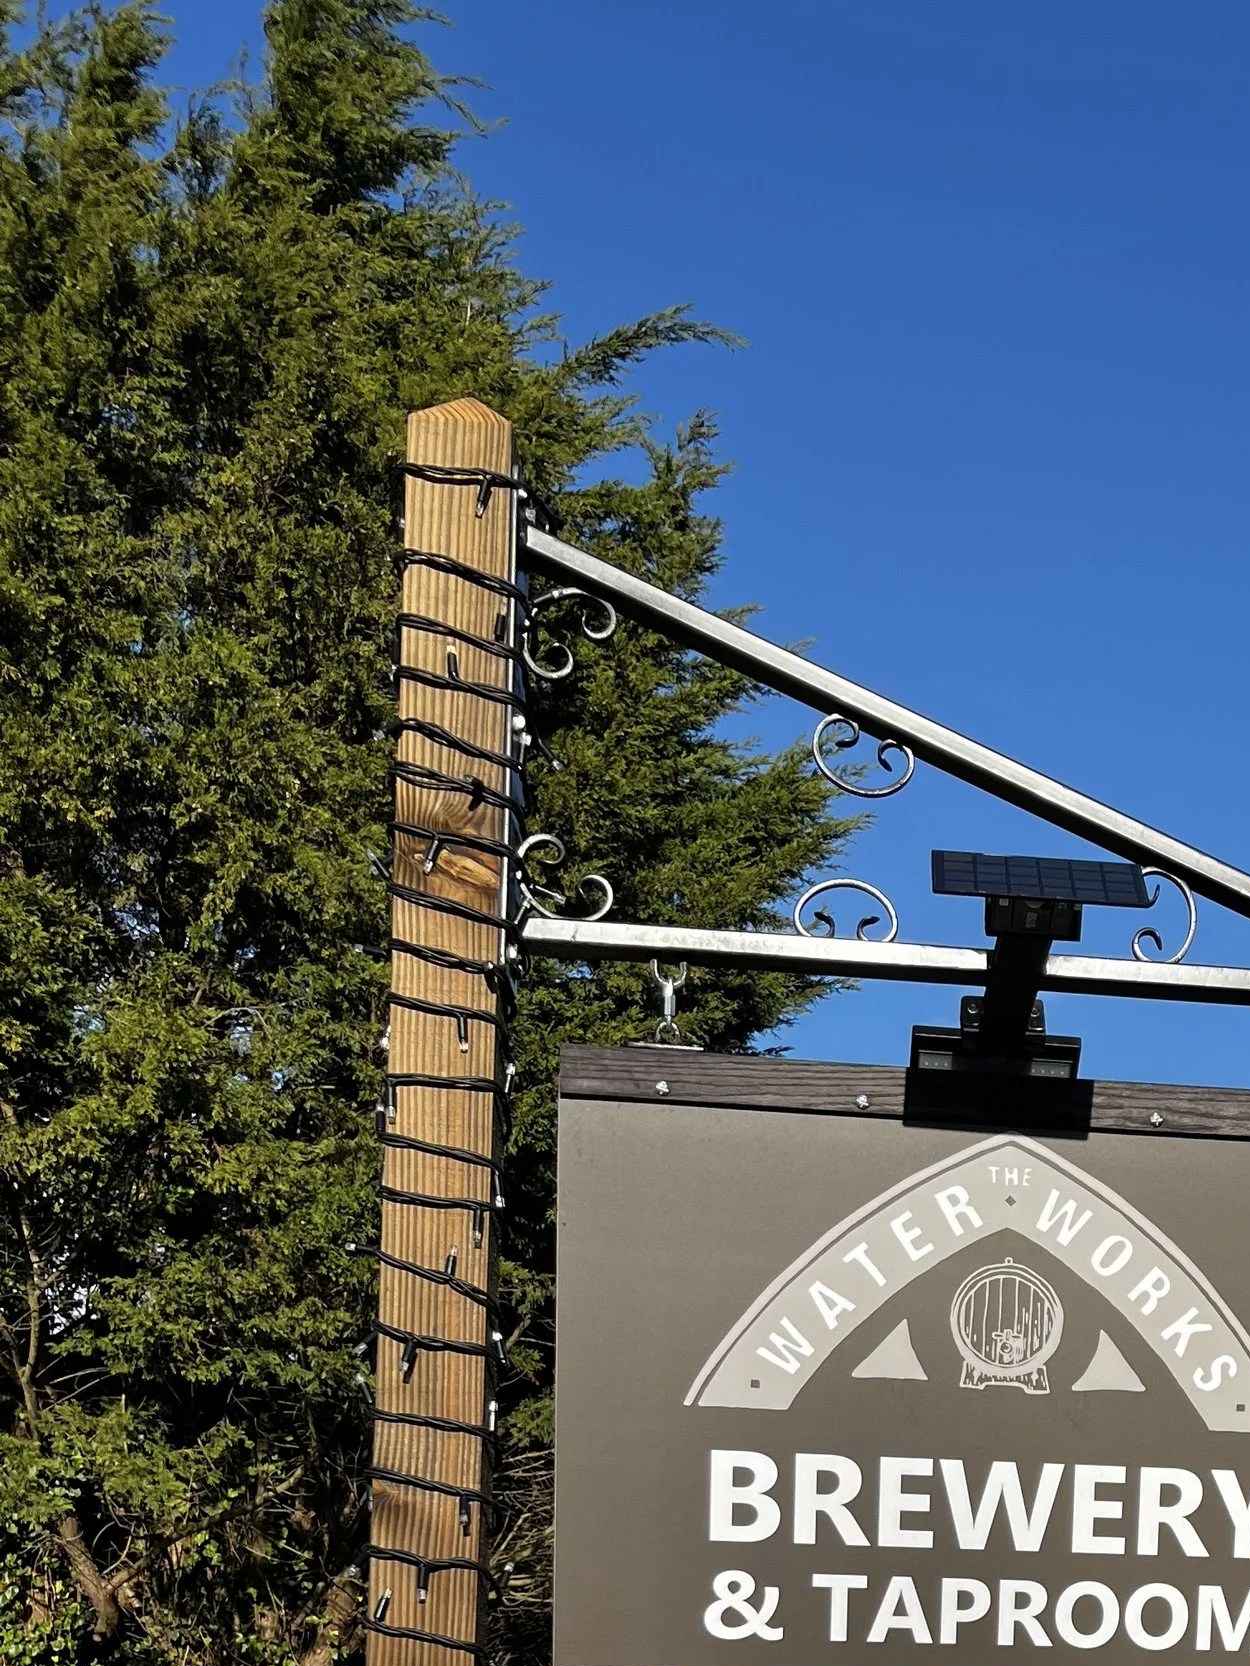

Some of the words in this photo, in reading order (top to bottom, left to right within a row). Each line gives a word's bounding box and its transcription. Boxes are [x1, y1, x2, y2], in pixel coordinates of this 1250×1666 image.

[987, 1165, 1033, 1187] THE
[755, 1183, 985, 1376] WATER
[1033, 1188, 1239, 1394] WORKS
[702, 1569, 785, 1642] &
